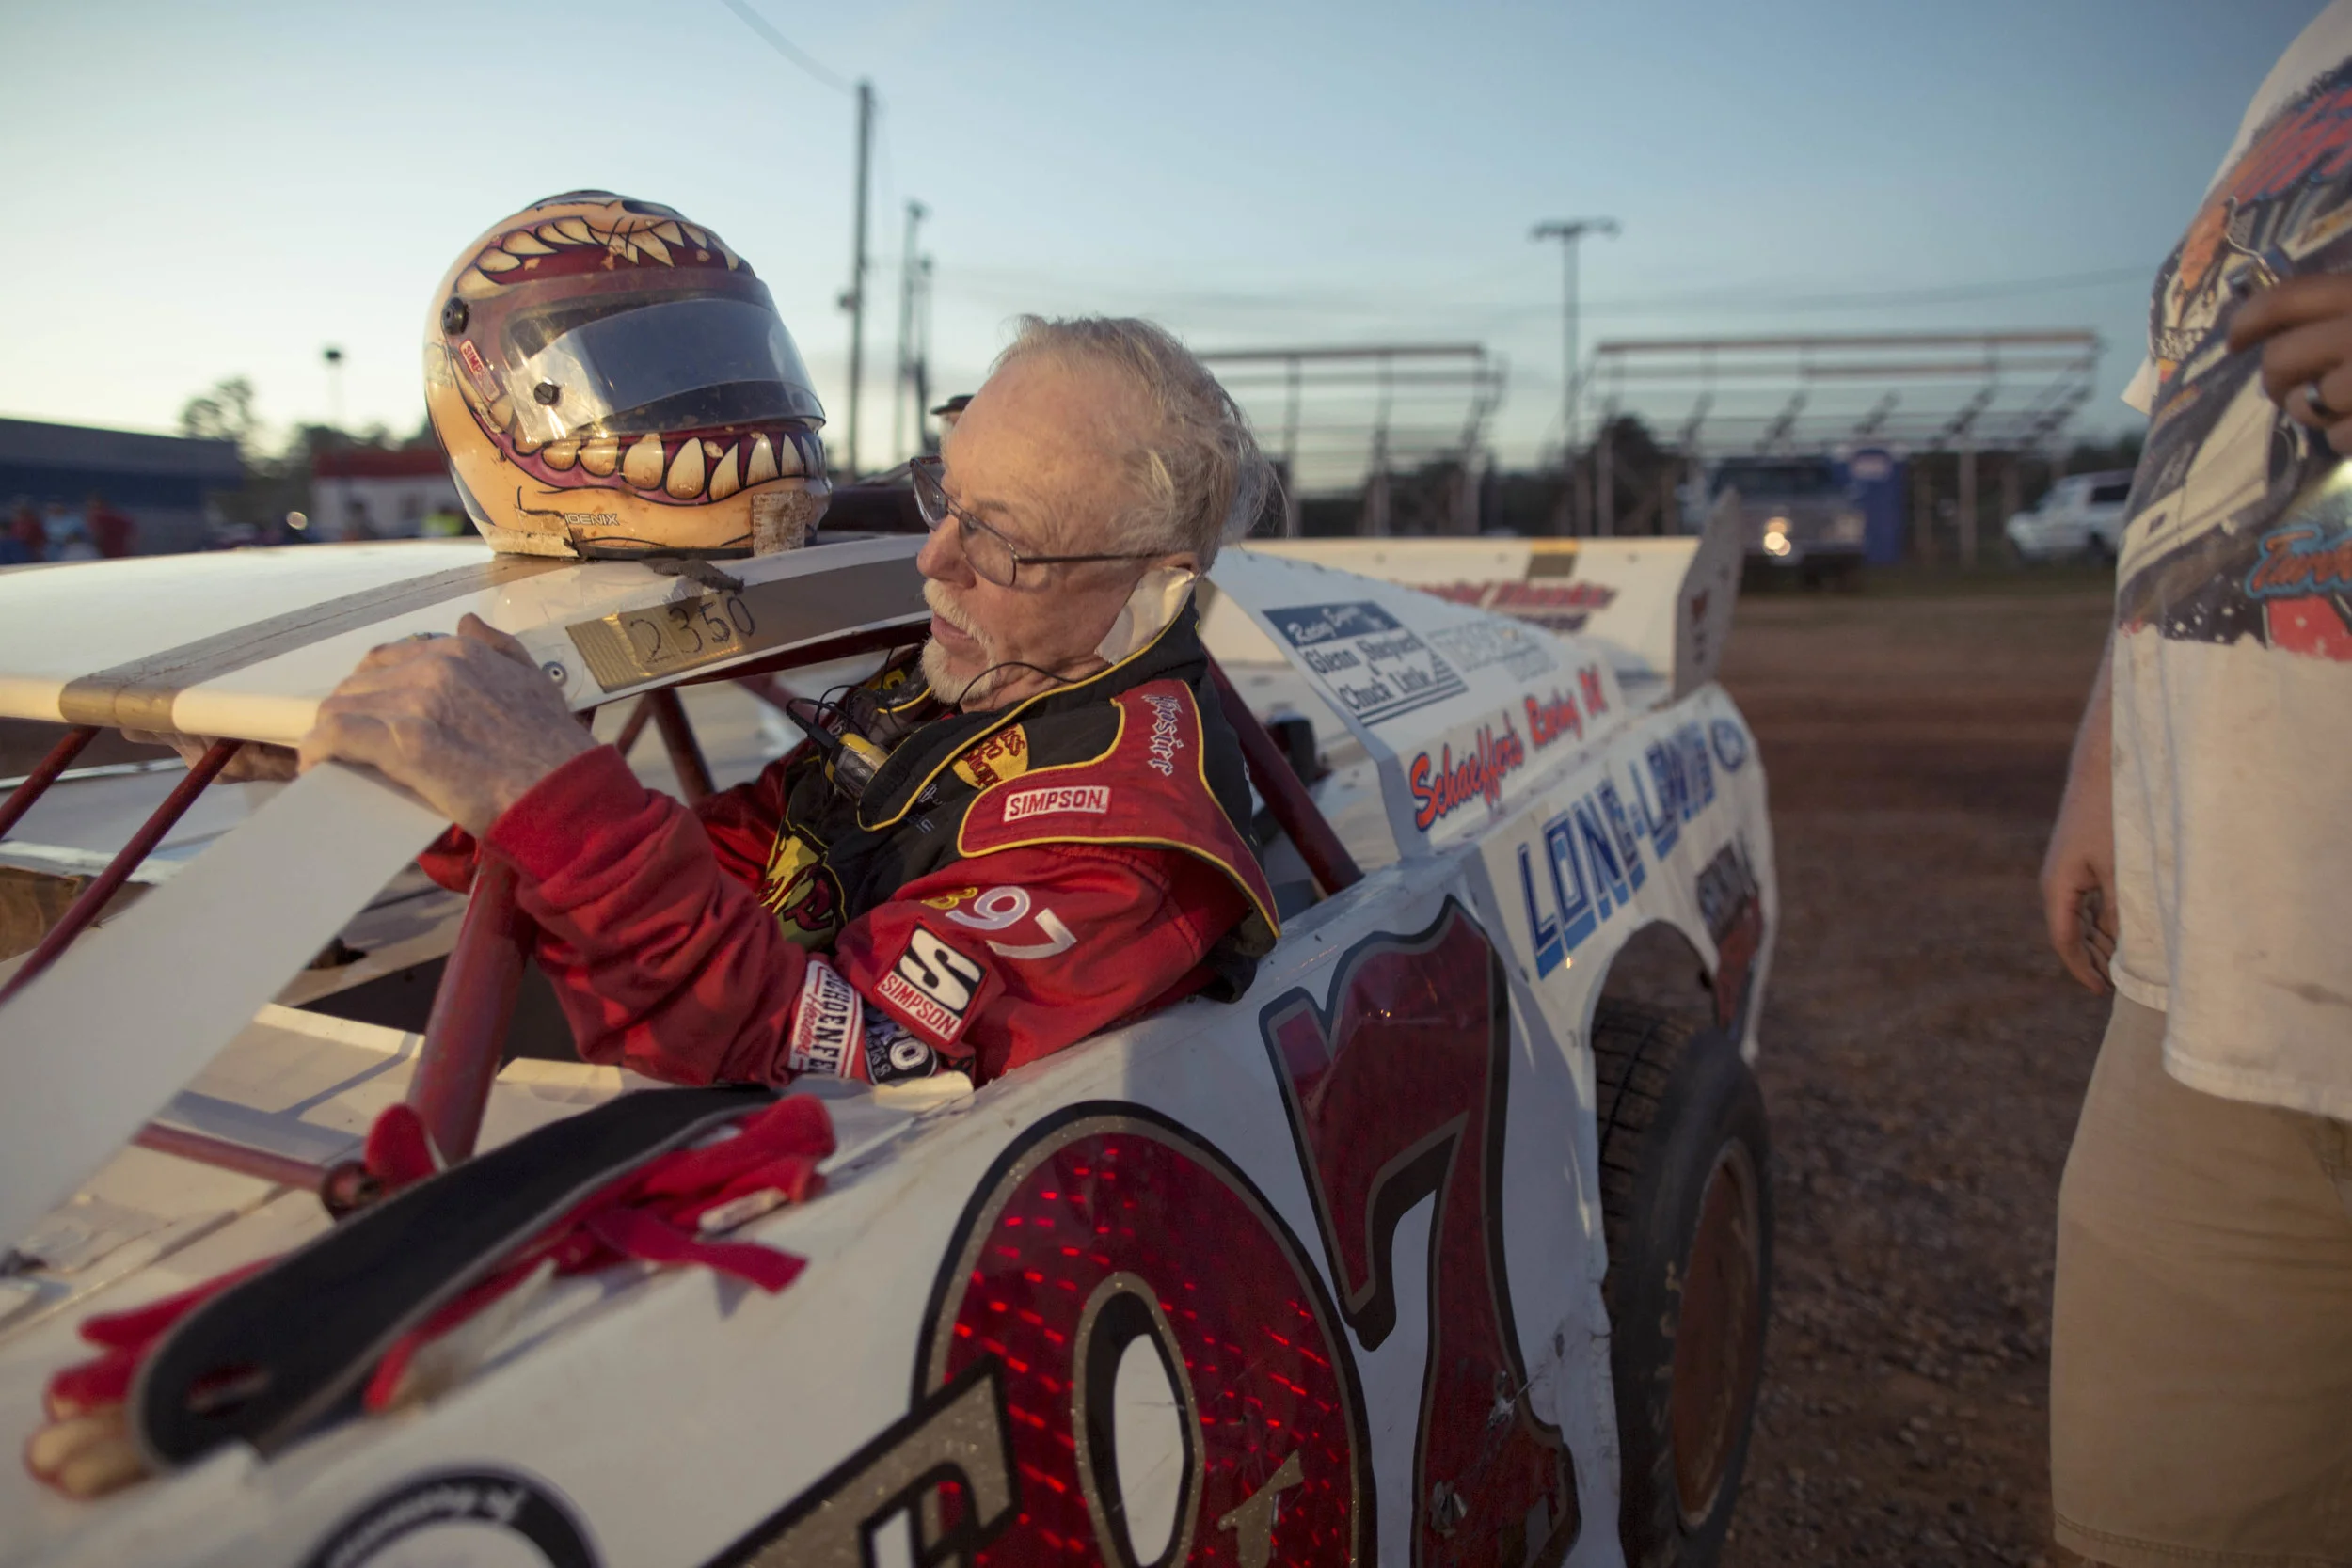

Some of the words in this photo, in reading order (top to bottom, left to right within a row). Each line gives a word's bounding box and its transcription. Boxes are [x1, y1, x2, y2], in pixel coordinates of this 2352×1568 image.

[629, 596, 756, 664] 2350
[1337, 676, 1397, 711] Chuck
[1009, 789, 1104, 817] SIMPSON
[881, 974, 959, 1037] SIMPSON
